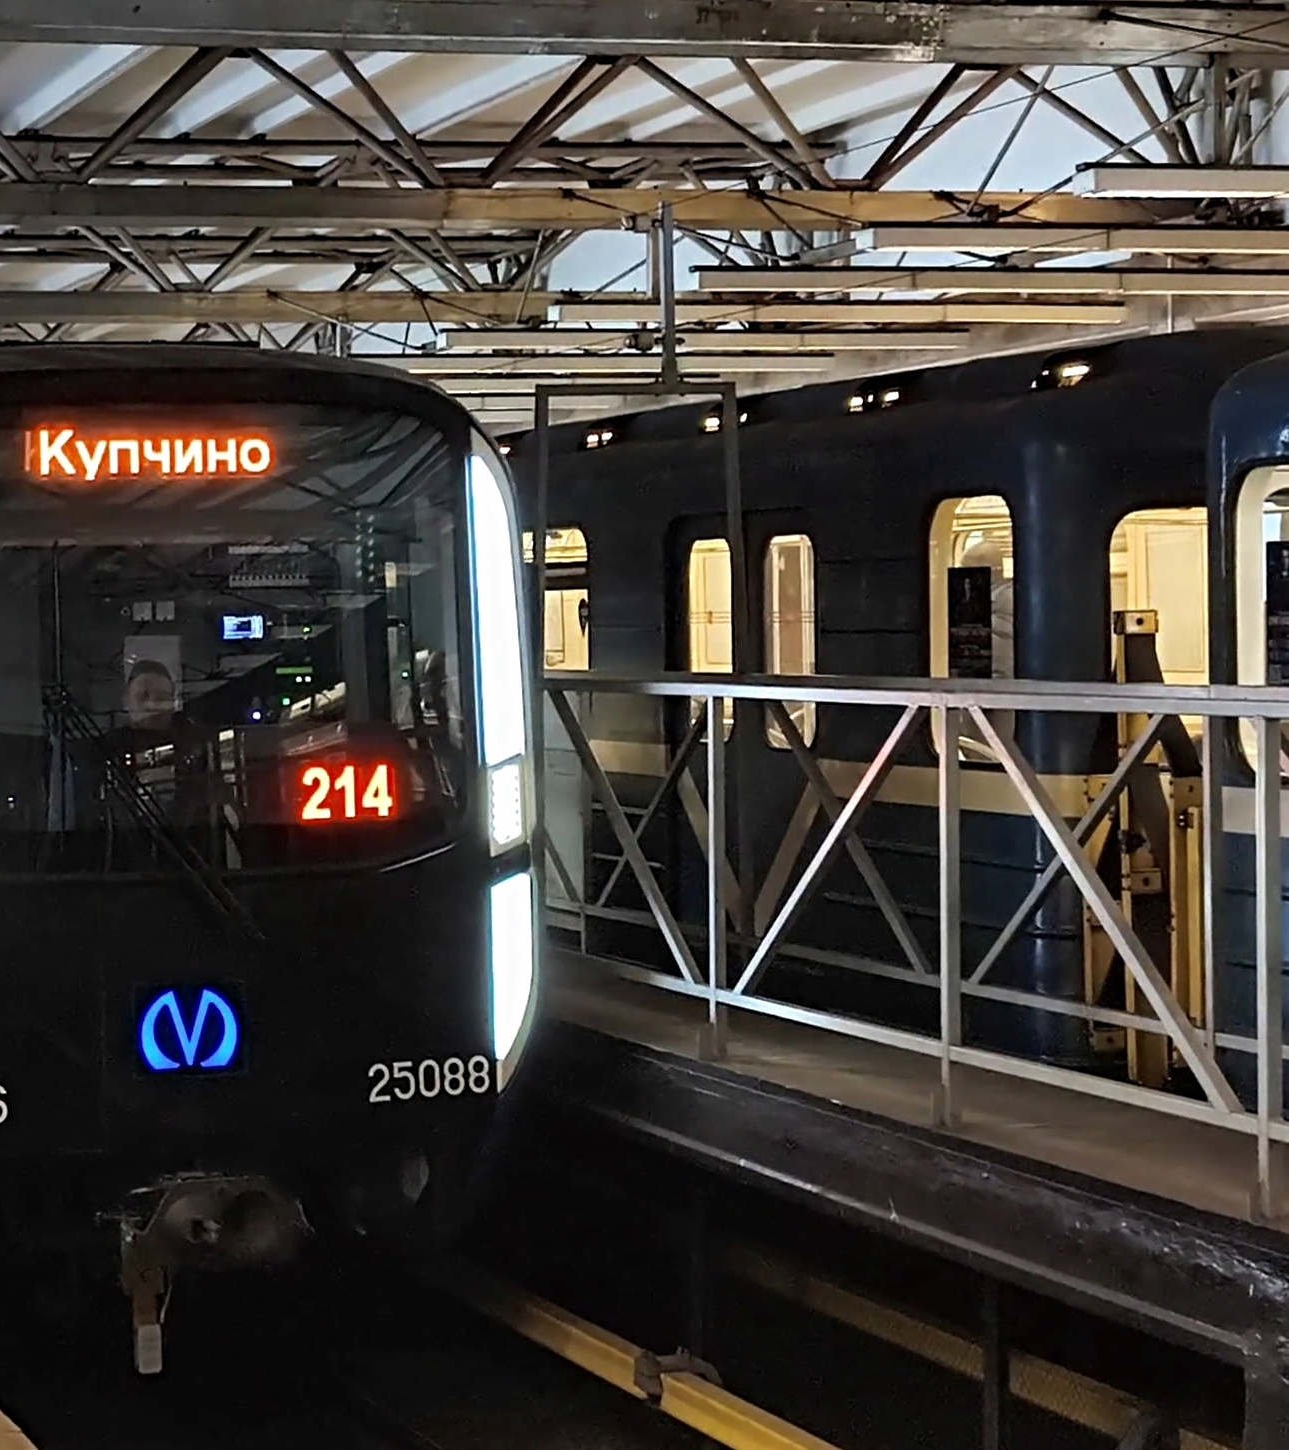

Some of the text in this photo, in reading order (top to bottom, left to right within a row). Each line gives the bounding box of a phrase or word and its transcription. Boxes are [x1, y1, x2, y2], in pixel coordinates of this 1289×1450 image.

[38, 428, 271, 481] Купчино
[301, 763, 394, 820] 214
[367, 1054, 491, 1103] 25088
